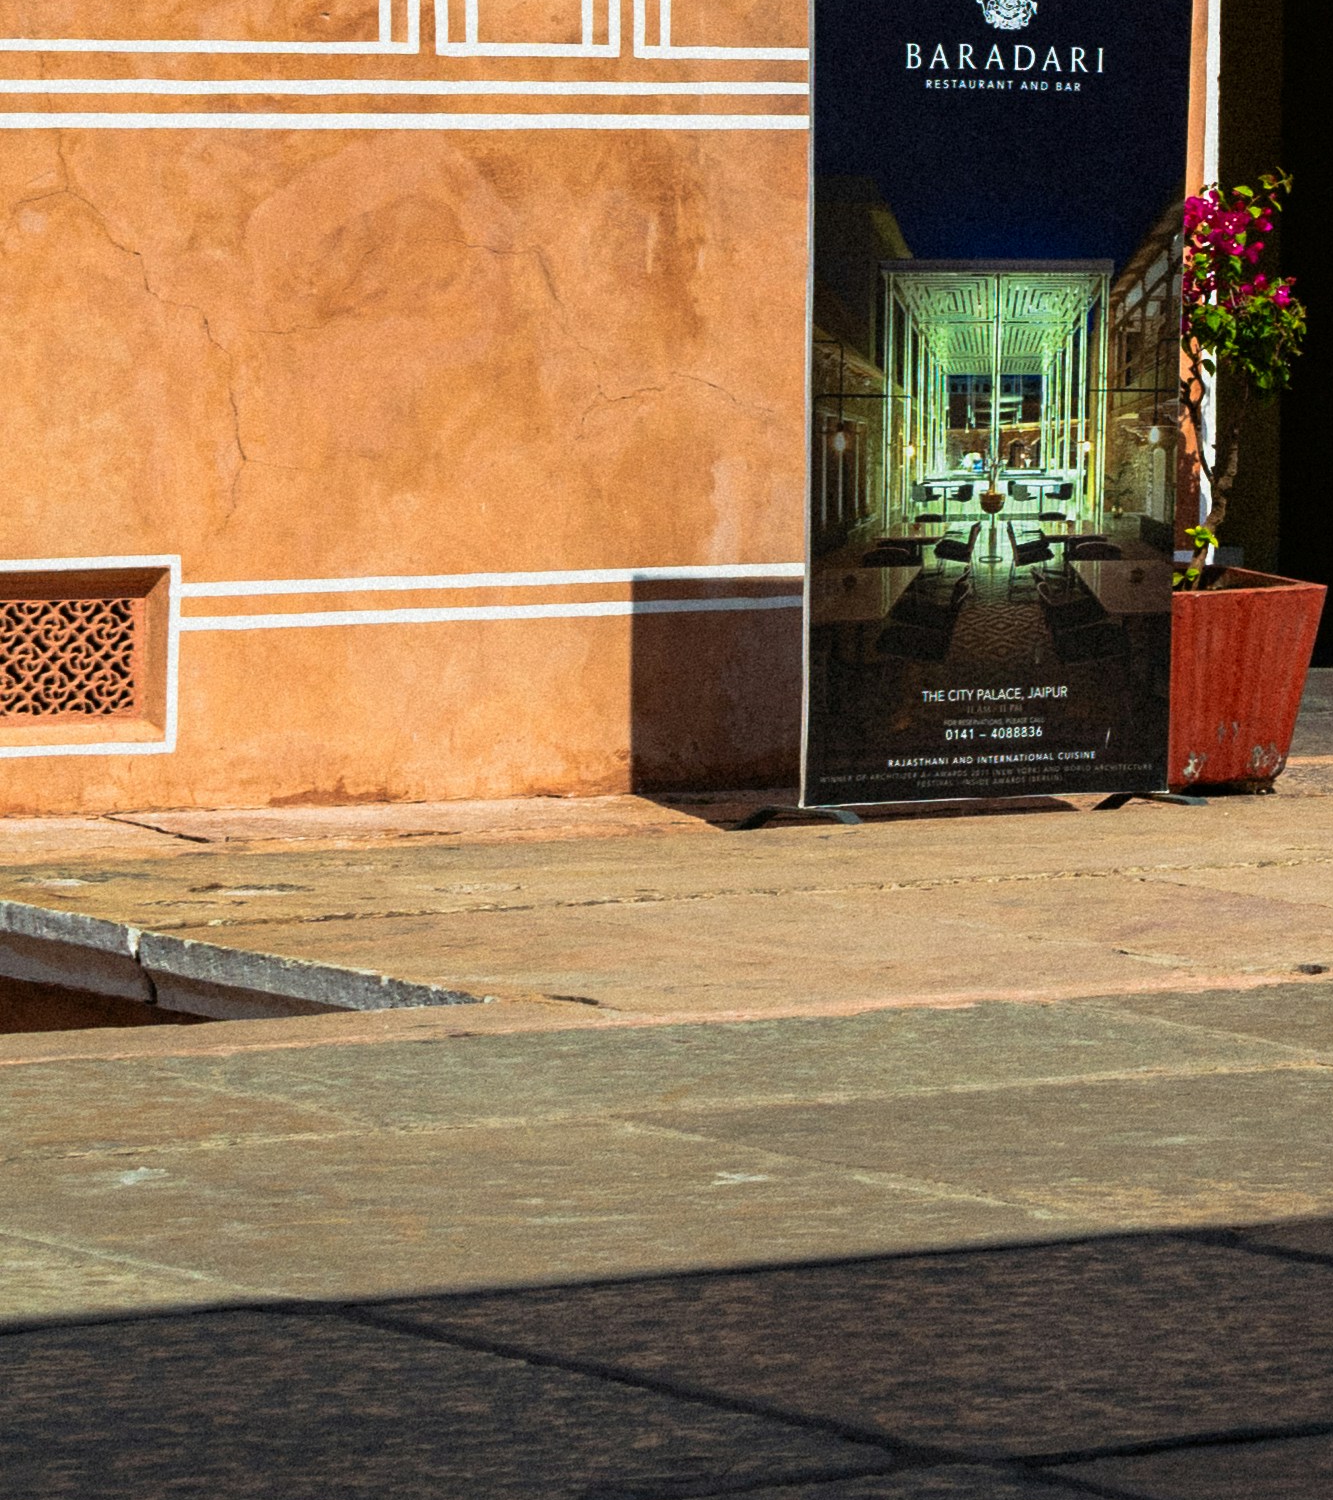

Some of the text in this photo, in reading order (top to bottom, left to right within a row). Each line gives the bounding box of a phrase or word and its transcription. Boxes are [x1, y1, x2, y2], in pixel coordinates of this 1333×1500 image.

[905, 43, 1104, 73] BARADARI
[925, 79, 1082, 92] RESTAURANT AND BAR
[921, 685, 1069, 703] THE CITY PALACE, JAIPUR
[945, 728, 975, 741] 0141
[990, 726, 1043, 740] 4088836
[887, 750, 1096, 768] RAJASTHANI AND INTERNATIONAL CUISINE
